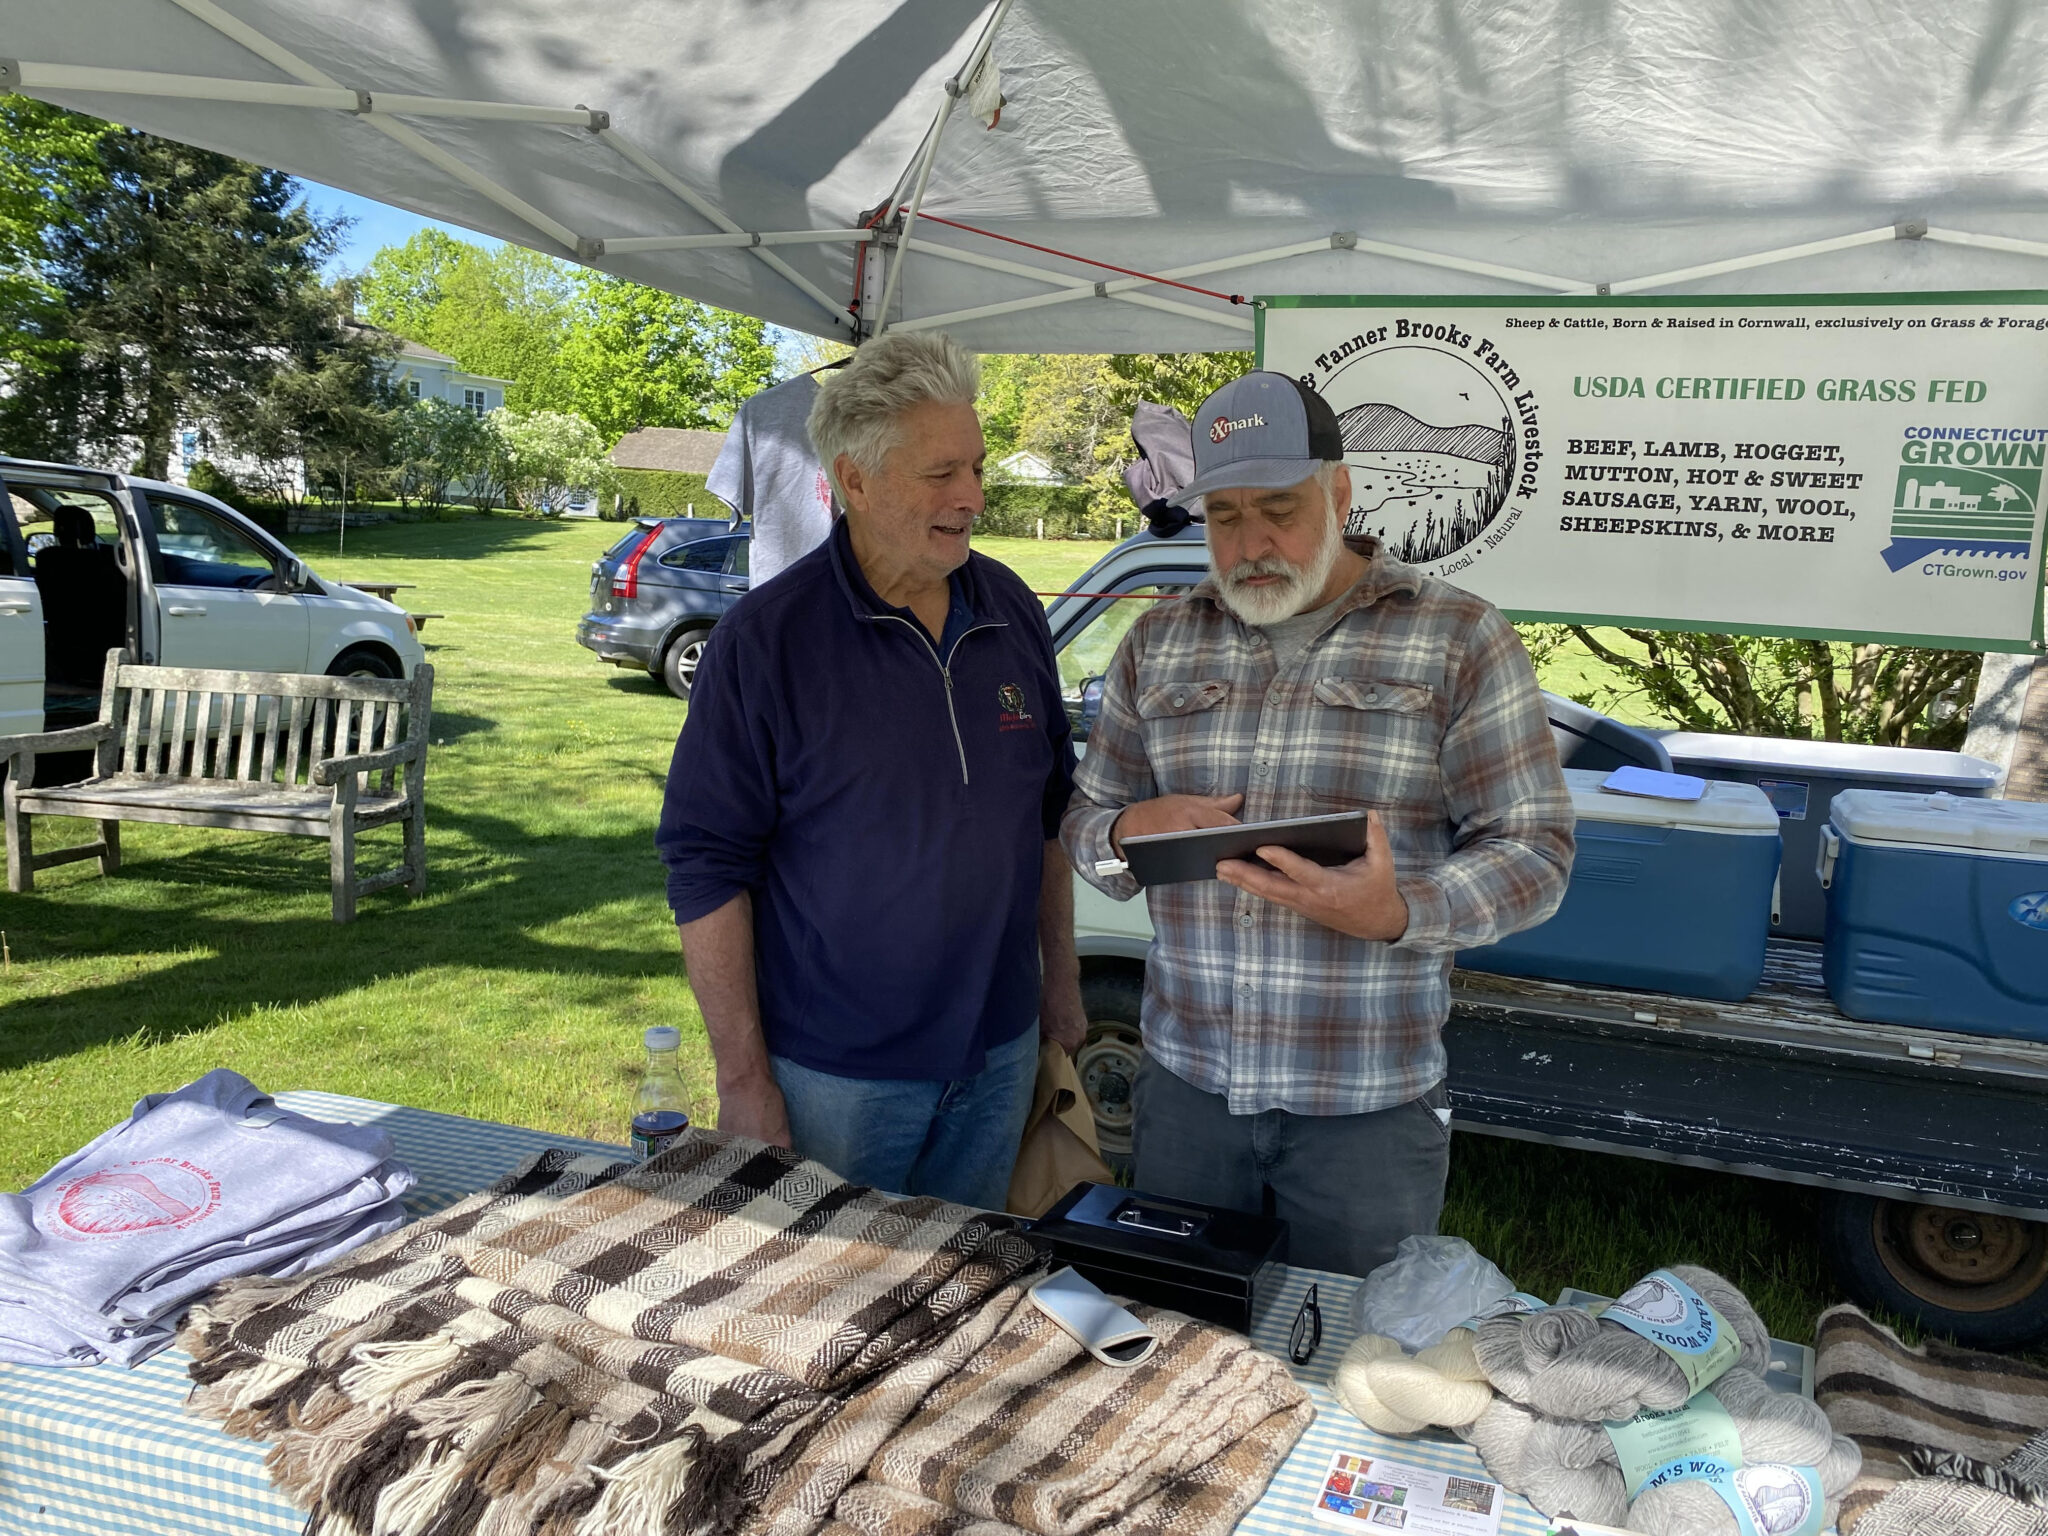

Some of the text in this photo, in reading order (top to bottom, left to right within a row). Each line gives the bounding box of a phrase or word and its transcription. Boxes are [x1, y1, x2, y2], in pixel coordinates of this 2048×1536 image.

[1505, 318, 1545, 330] Sheep
[1549, 318, 1560, 328] &
[1563, 318, 1609, 330] Cattle,
[1612, 318, 1647, 328] Born
[1651, 318, 1663, 328] &
[1666, 318, 1715, 328] Raised
[1719, 317, 1734, 328] in
[1738, 317, 1810, 330] Cornwall,
[1814, 317, 1904, 331] exclusively
[1907, 319, 1926, 328] on
[1930, 317, 1976, 328] Grass
[1979, 317, 1993, 328] &
[1573, 376, 1988, 403] USDA CERTIFIED GRASS FED
[1314, 325, 1387, 373] Tanner
[1396, 319, 1472, 349] Brooks
[1473, 338, 1521, 391] Farm
[1514, 390, 1544, 500] Livestock
[1903, 426, 2048, 442] CONNECTICUT
[1566, 439, 1845, 466] BEEF, LAMB, HOGGET,
[1901, 440, 2047, 467] GROWN
[1564, 465, 1864, 490] MUTTON, HOT & SWEET
[1562, 491, 1857, 521] SAUSAGE, YARN, WOOL,
[1439, 506, 1523, 577] Local Natural
[1559, 516, 1835, 543] SHEEPSKINS, & MORE
[1922, 563, 2028, 582] CTGrown.gov
[1690, 1297, 1713, 1344] SAM'S
[1651, 1328, 1703, 1350] WOOL
[1632, 1410, 1666, 1424] Brooks
[1650, 1461, 1725, 1488] M'S WOO
